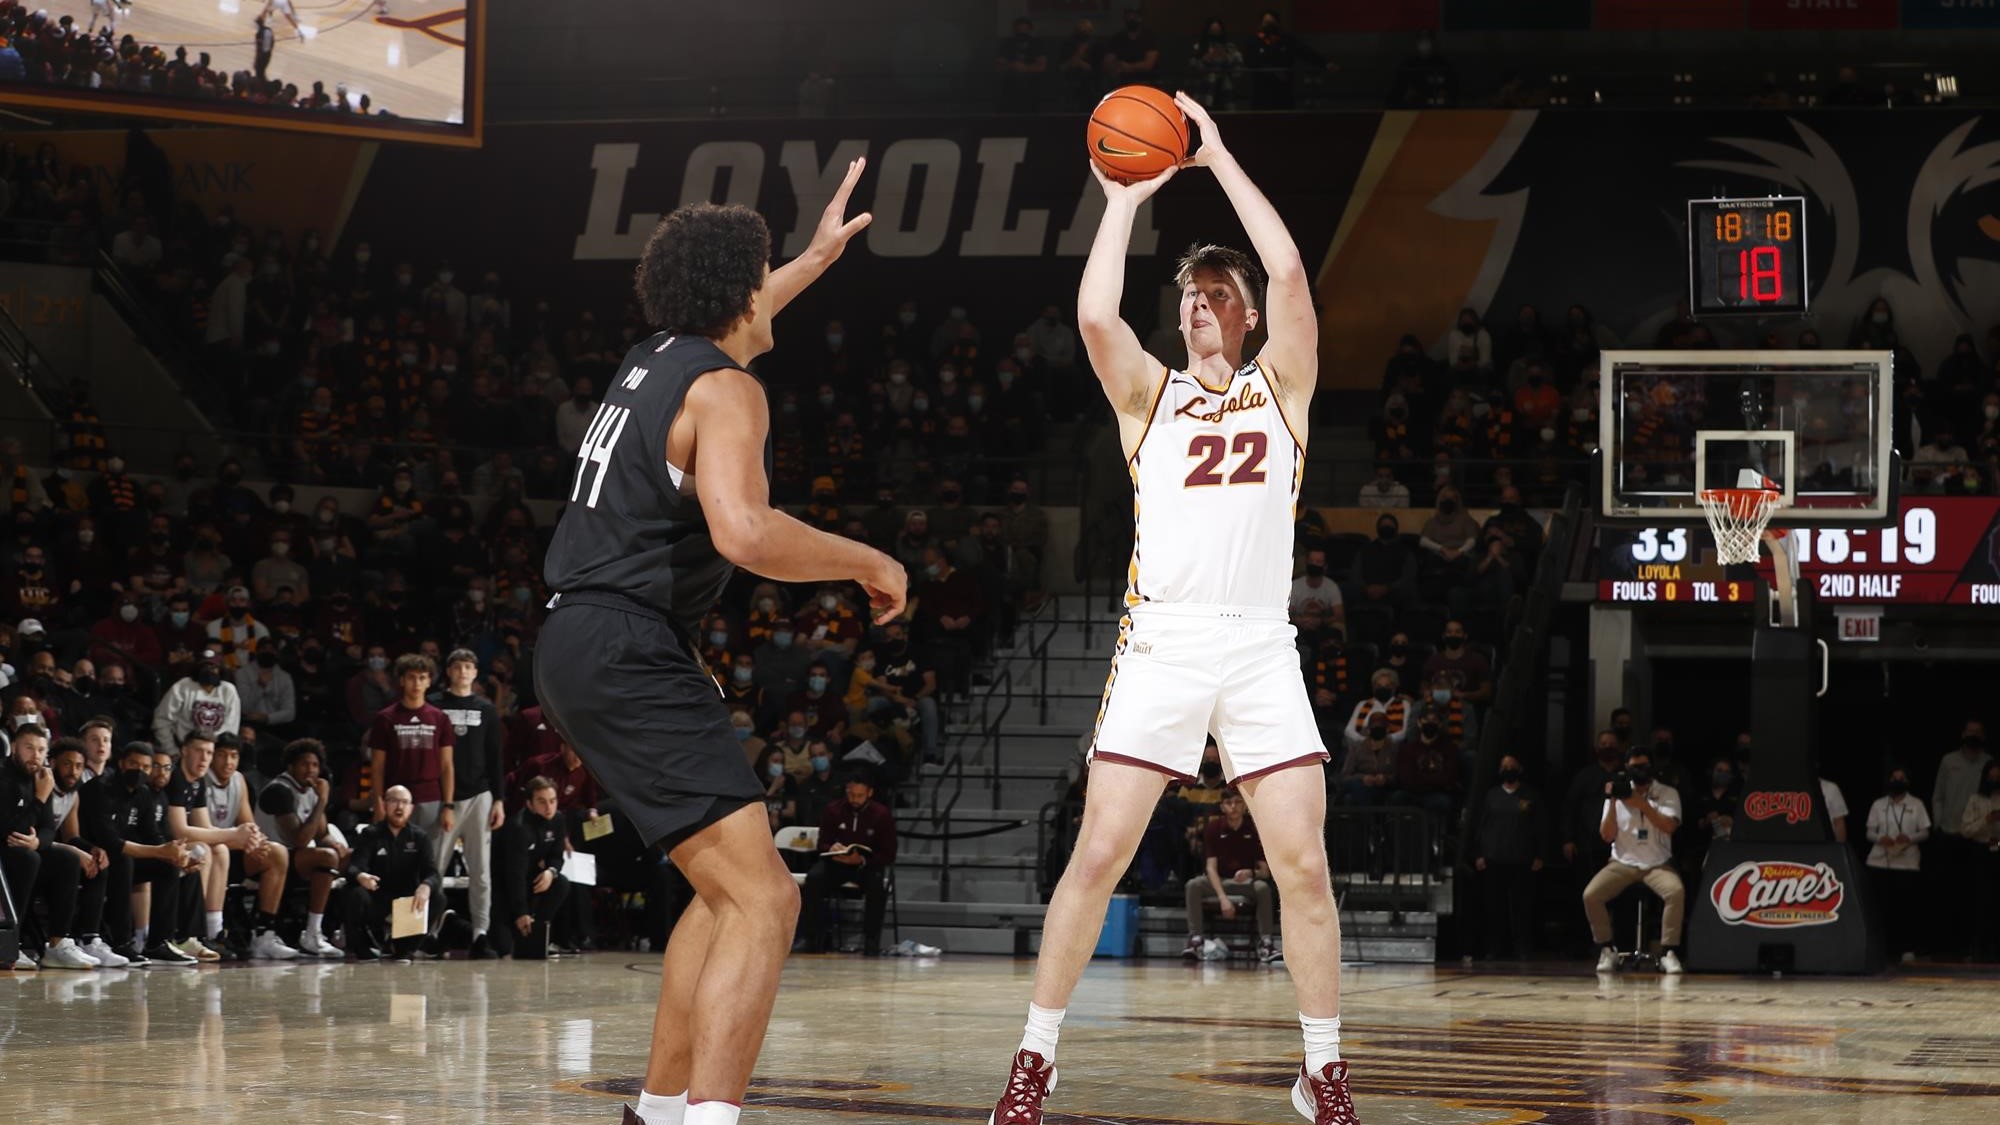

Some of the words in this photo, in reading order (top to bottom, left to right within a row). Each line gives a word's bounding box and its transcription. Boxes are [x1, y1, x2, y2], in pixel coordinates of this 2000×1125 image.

[1738, 245, 1783, 303] 18
[1175, 382, 1267, 423] Loyola
[571, 402, 631, 509] 44
[1184, 431, 1268, 488] 22
[1632, 528, 1687, 562] 33
[1638, 564, 1681, 580] LOYOLA
[1819, 574, 1855, 598] 2ND
[1858, 574, 1902, 598] HALF
[1612, 580, 1657, 601] FOULS
[1665, 582, 1677, 601] 0
[1692, 581, 1719, 602] TOL
[1728, 582, 1739, 602] 3
[1971, 584, 2000, 604] FOU
[1844, 618, 1875, 638] EXIT
[1761, 866, 1805, 879] Raising
[1719, 862, 1839, 921] Cane's
